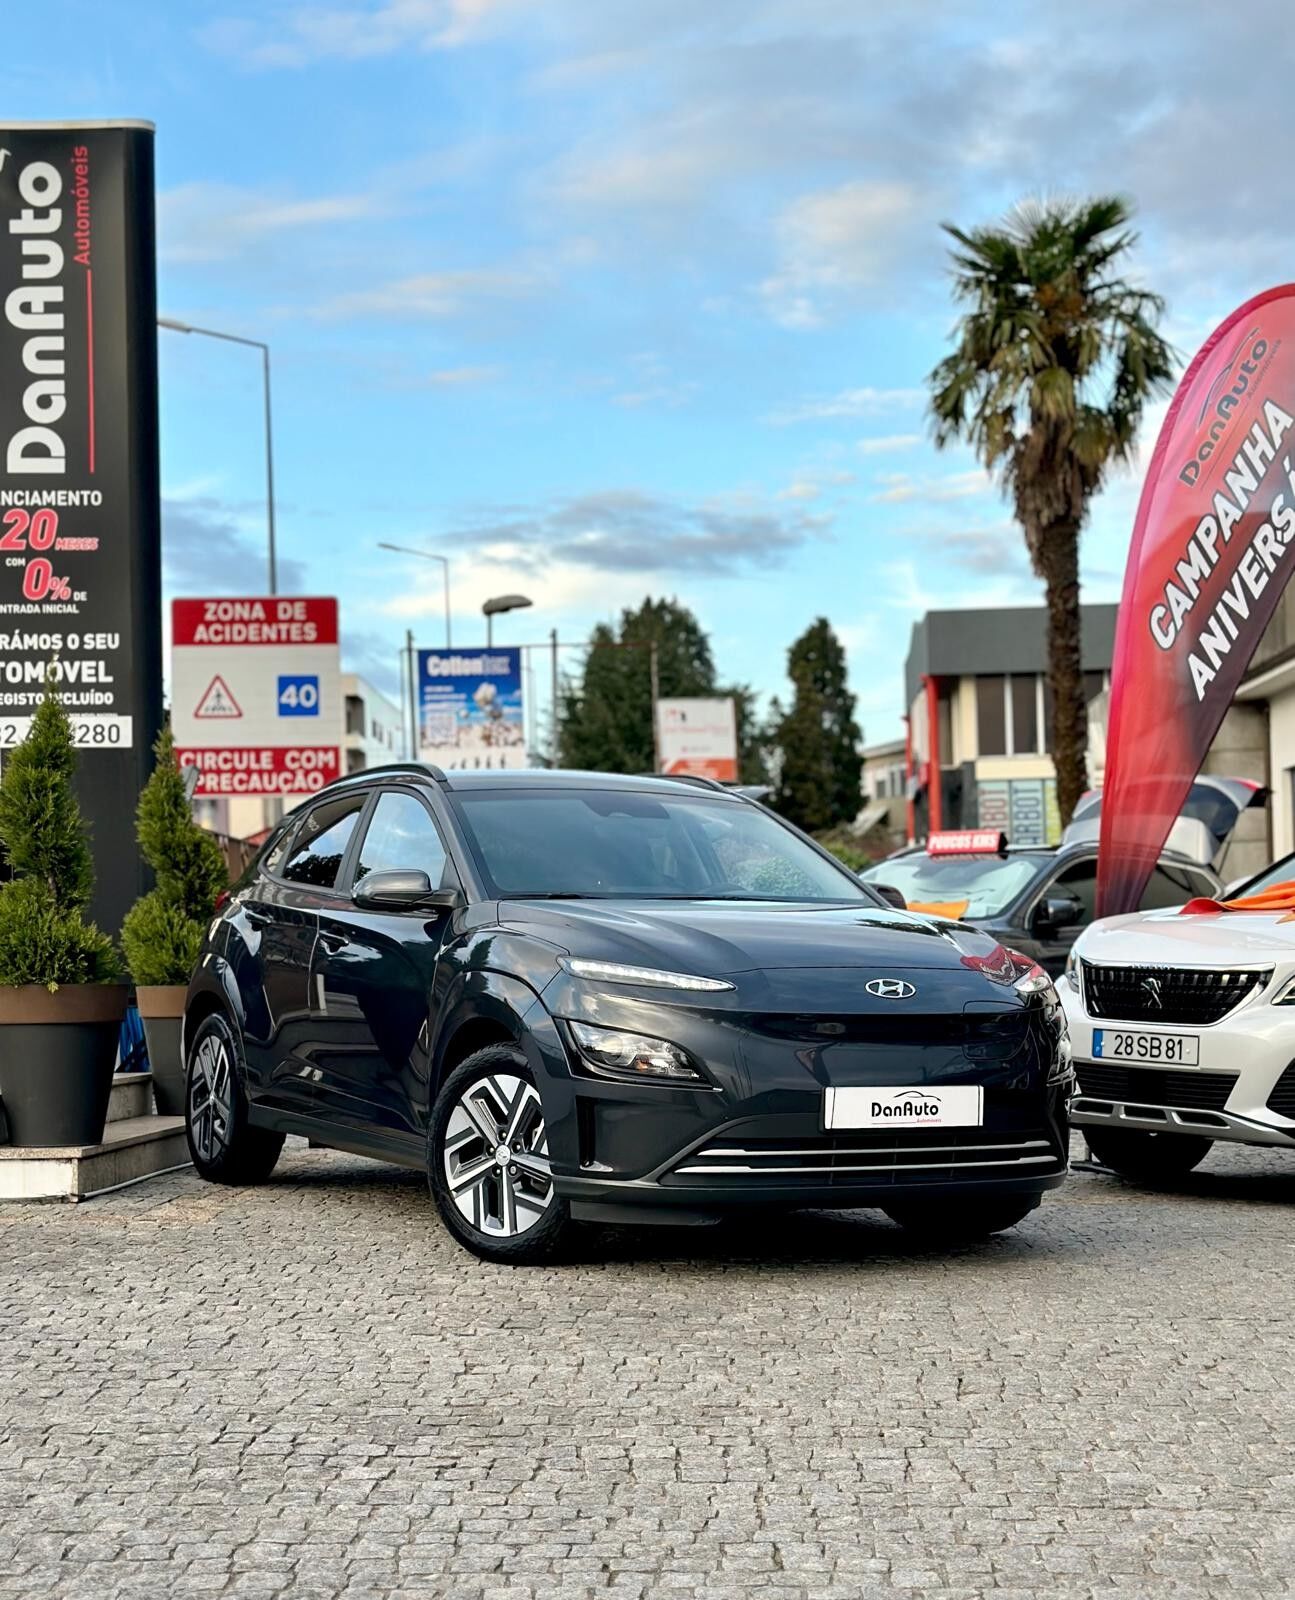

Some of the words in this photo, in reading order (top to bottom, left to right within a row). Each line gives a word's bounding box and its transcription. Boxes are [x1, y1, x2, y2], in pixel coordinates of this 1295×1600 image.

[71, 146, 91, 265] Automóveis
[5, 161, 66, 473] DanAuto
[1179, 339, 1267, 487] DanAuto
[0, 490, 103, 506] NCIAMENTO
[0, 508, 59, 551] 20
[1150, 399, 1295, 650] CAMPANHA
[5, 558, 26, 567] COM
[23, 557, 72, 601] 0%
[73, 591, 88, 602] DE
[42, 604, 79, 614] INICIAL
[204, 602, 266, 621] ZONA
[277, 602, 307, 620] DE
[0, 628, 63, 650] RÁMOS
[67, 633, 80, 650] O
[83, 633, 120, 650] SEU
[193, 622, 318, 642] ACIDENTES
[279, 683, 317, 708] 40
[77, 723, 121, 744] 280
[180, 751, 274, 770] CIRCULE
[284, 750, 336, 769] COM
[1114, 1034, 1134, 1056] 28
[1137, 1036, 1162, 1058] SB
[1166, 1038, 1183, 1060] 81
[872, 1101, 939, 1117] DanAuto
